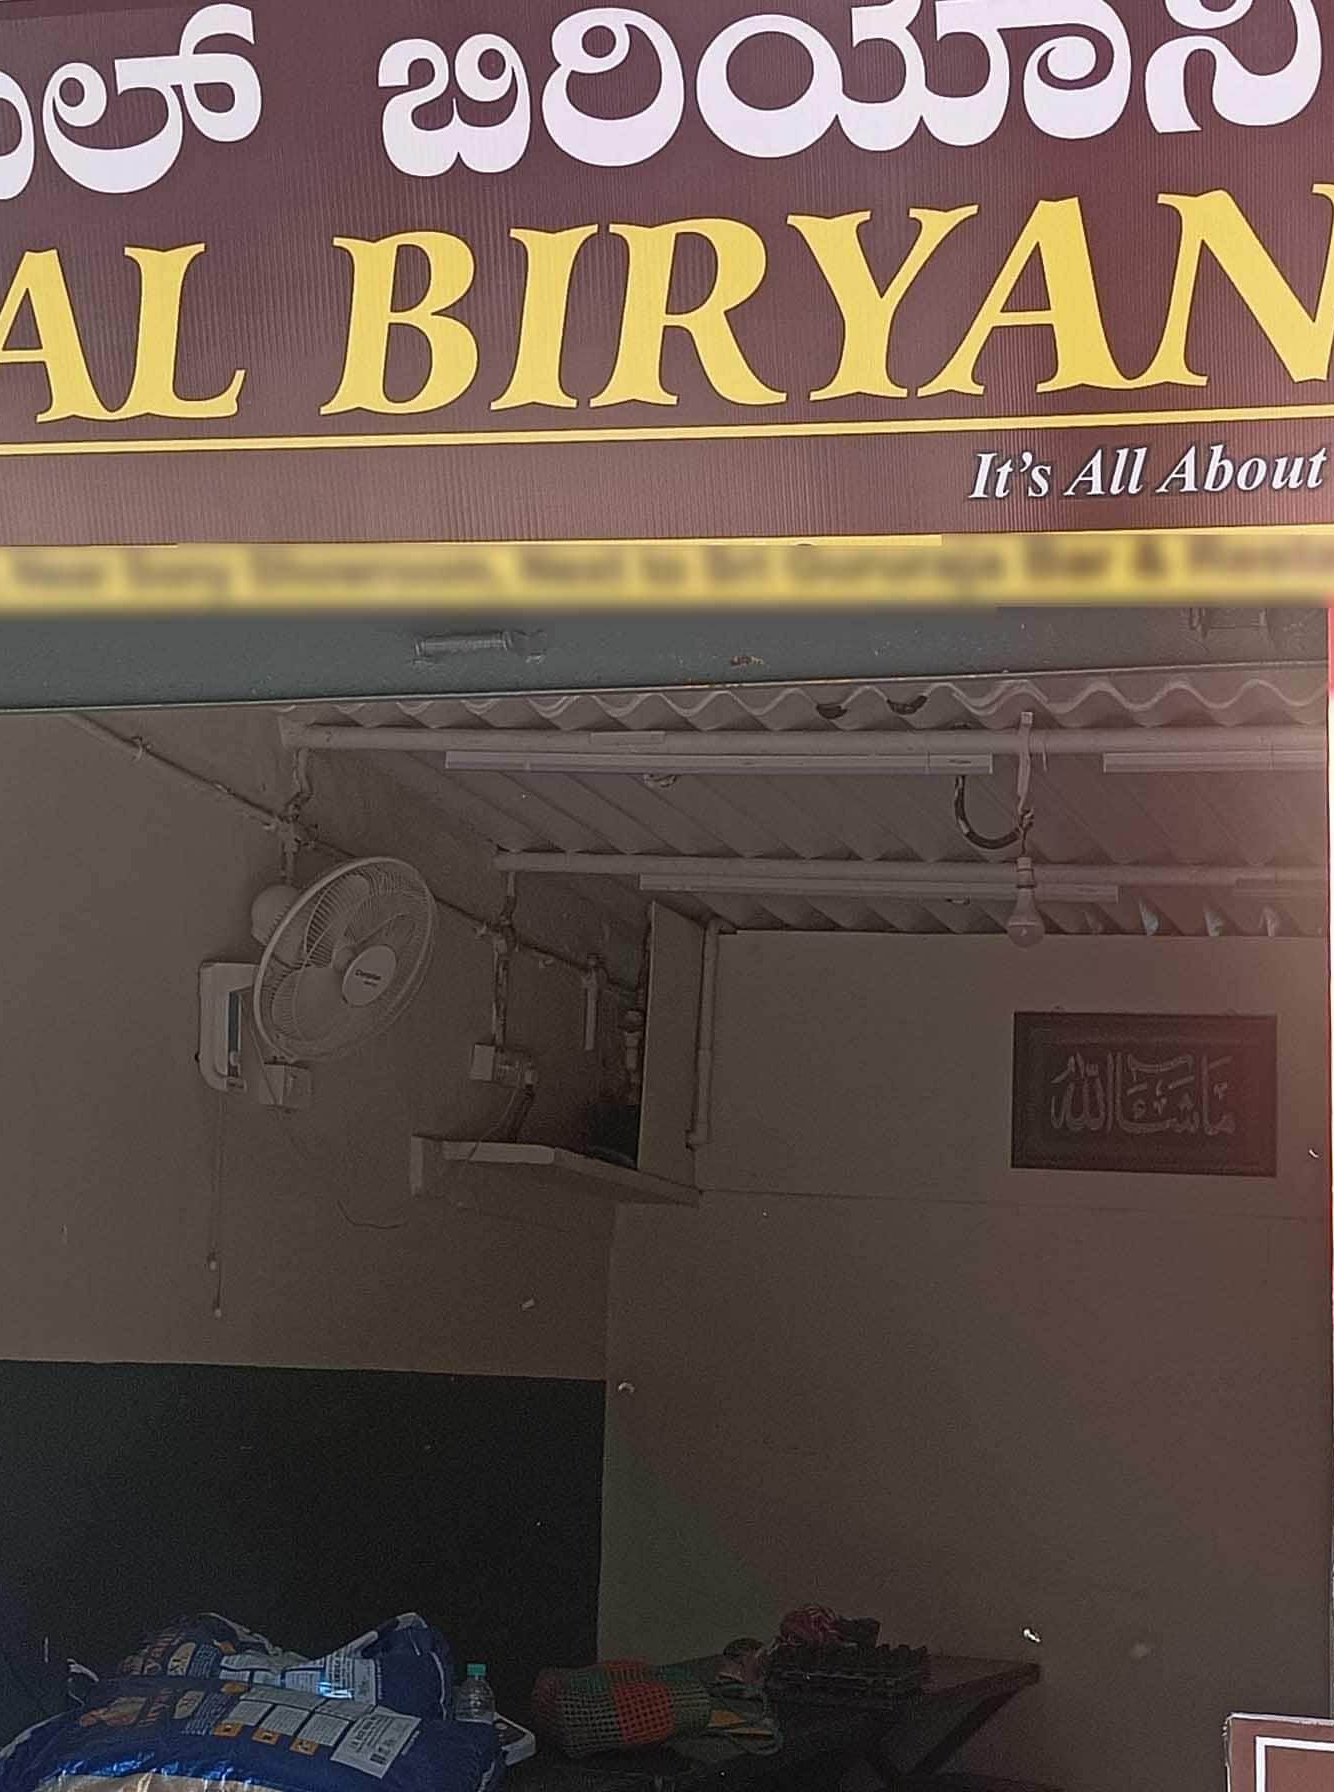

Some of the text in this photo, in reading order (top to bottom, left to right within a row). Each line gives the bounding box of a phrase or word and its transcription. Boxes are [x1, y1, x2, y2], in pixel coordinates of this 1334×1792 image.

[377, 0, 1325, 178] ಬಿರಿಯಾನಿ
[1062, 446, 1148, 497] All
[1155, 444, 1328, 494] About
